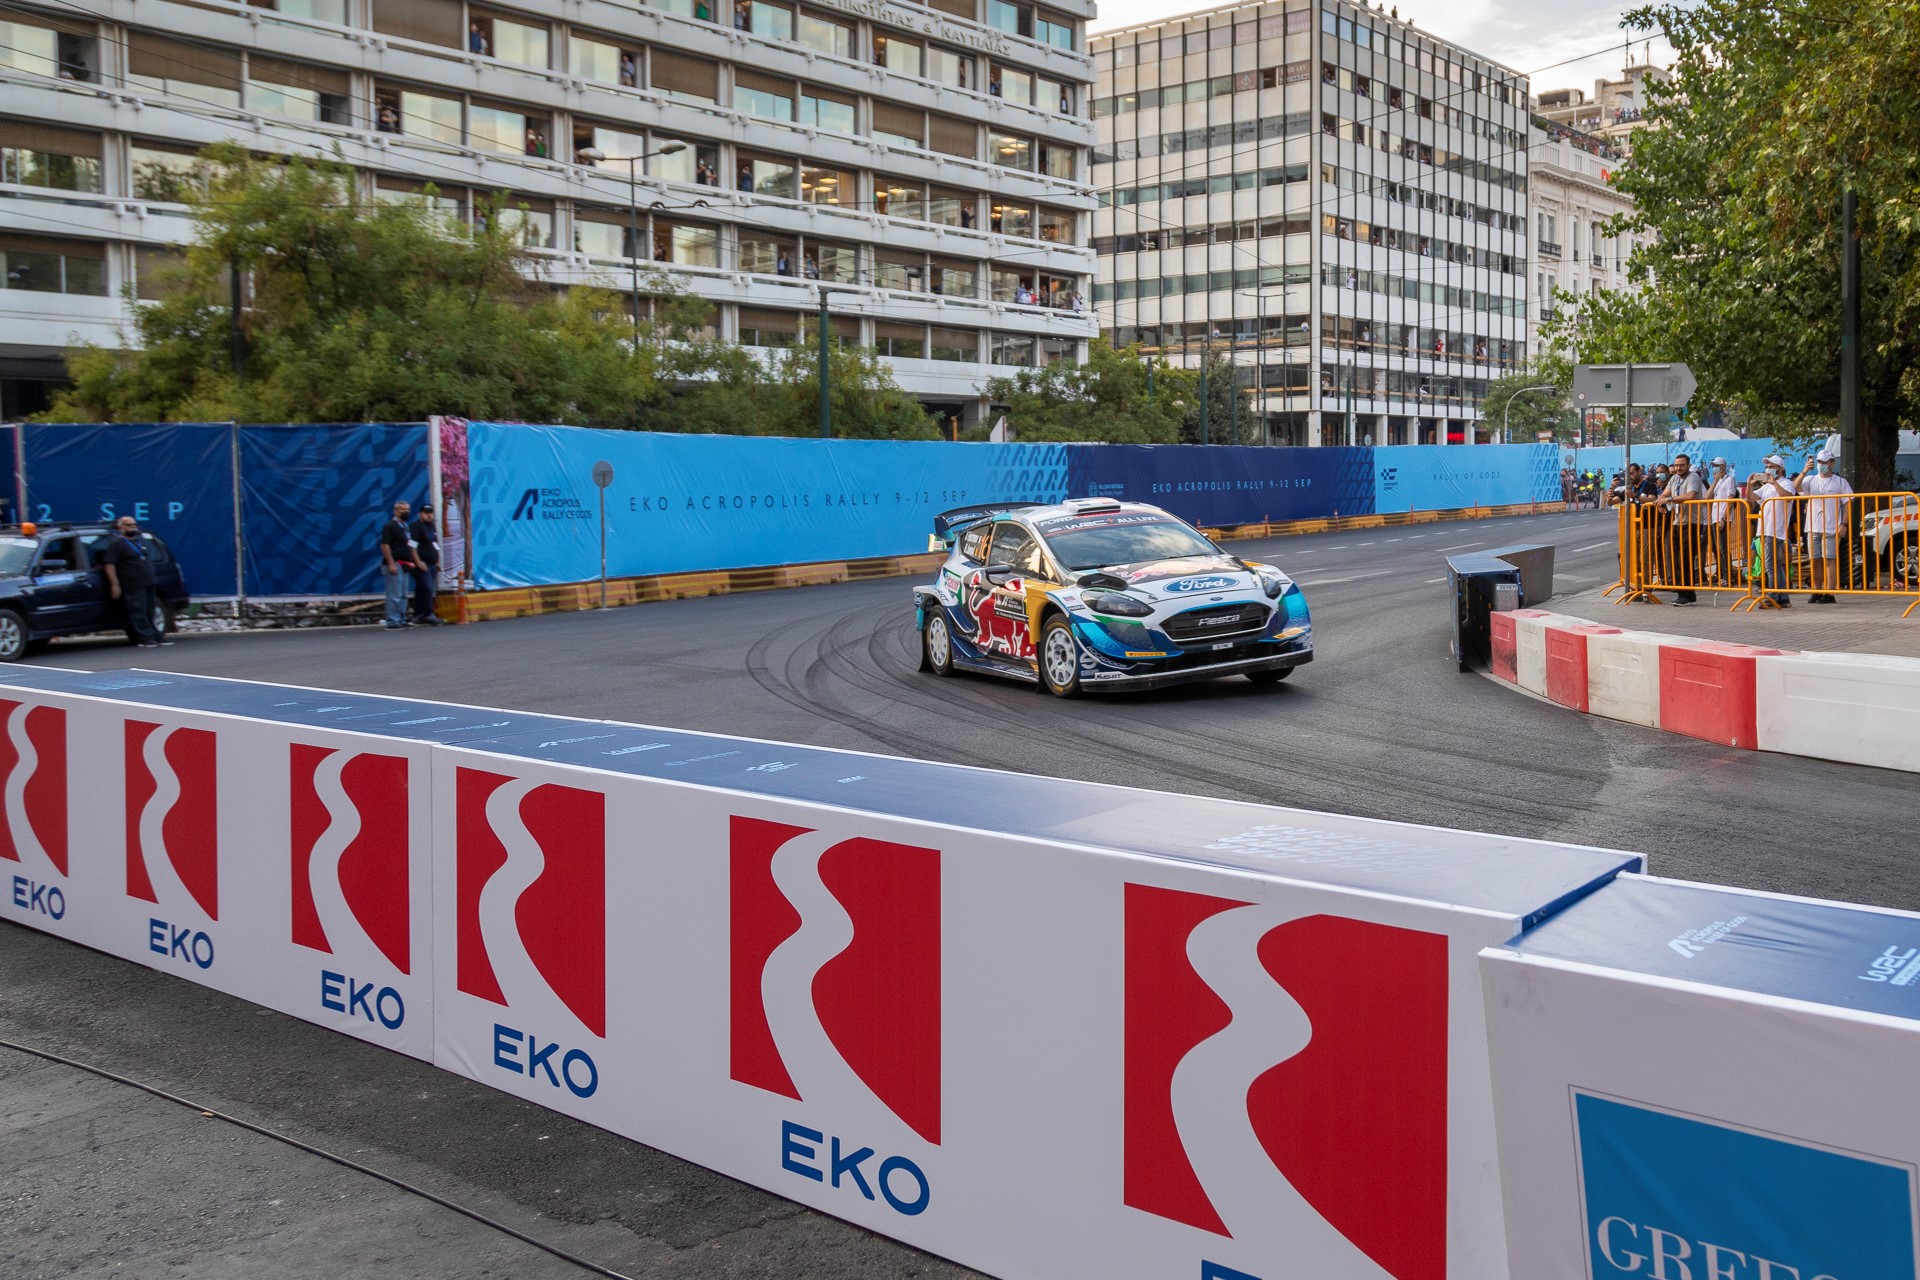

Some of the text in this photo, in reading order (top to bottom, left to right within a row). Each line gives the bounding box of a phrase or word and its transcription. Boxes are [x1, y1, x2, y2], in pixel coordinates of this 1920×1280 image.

[923, 23, 932, 33] &
[940, 25, 1011, 57] ΝΑΥΤΙΛΙΑΣ
[541, 488, 561, 496] EKO
[1152, 478, 1312, 493] EKO ACROPOLIS RALLY 9-12 SEP
[541, 498, 581, 508] ACROPOLIS
[630, 490, 967, 511] EKO ACROPOLIS RALLY 9-12 SEP
[102, 502, 184, 521] SEP
[542, 510, 564, 520] RALLY
[1040, 516, 1074, 527] FORD
[1179, 577, 1227, 591] Ford
[1198, 614, 1240, 626] Fiesta
[13, 875, 65, 920] EKO
[149, 918, 214, 969] EKO
[321, 969, 405, 1030] EKO
[493, 1023, 598, 1099] EKO
[781, 1119, 930, 1216] EKO
